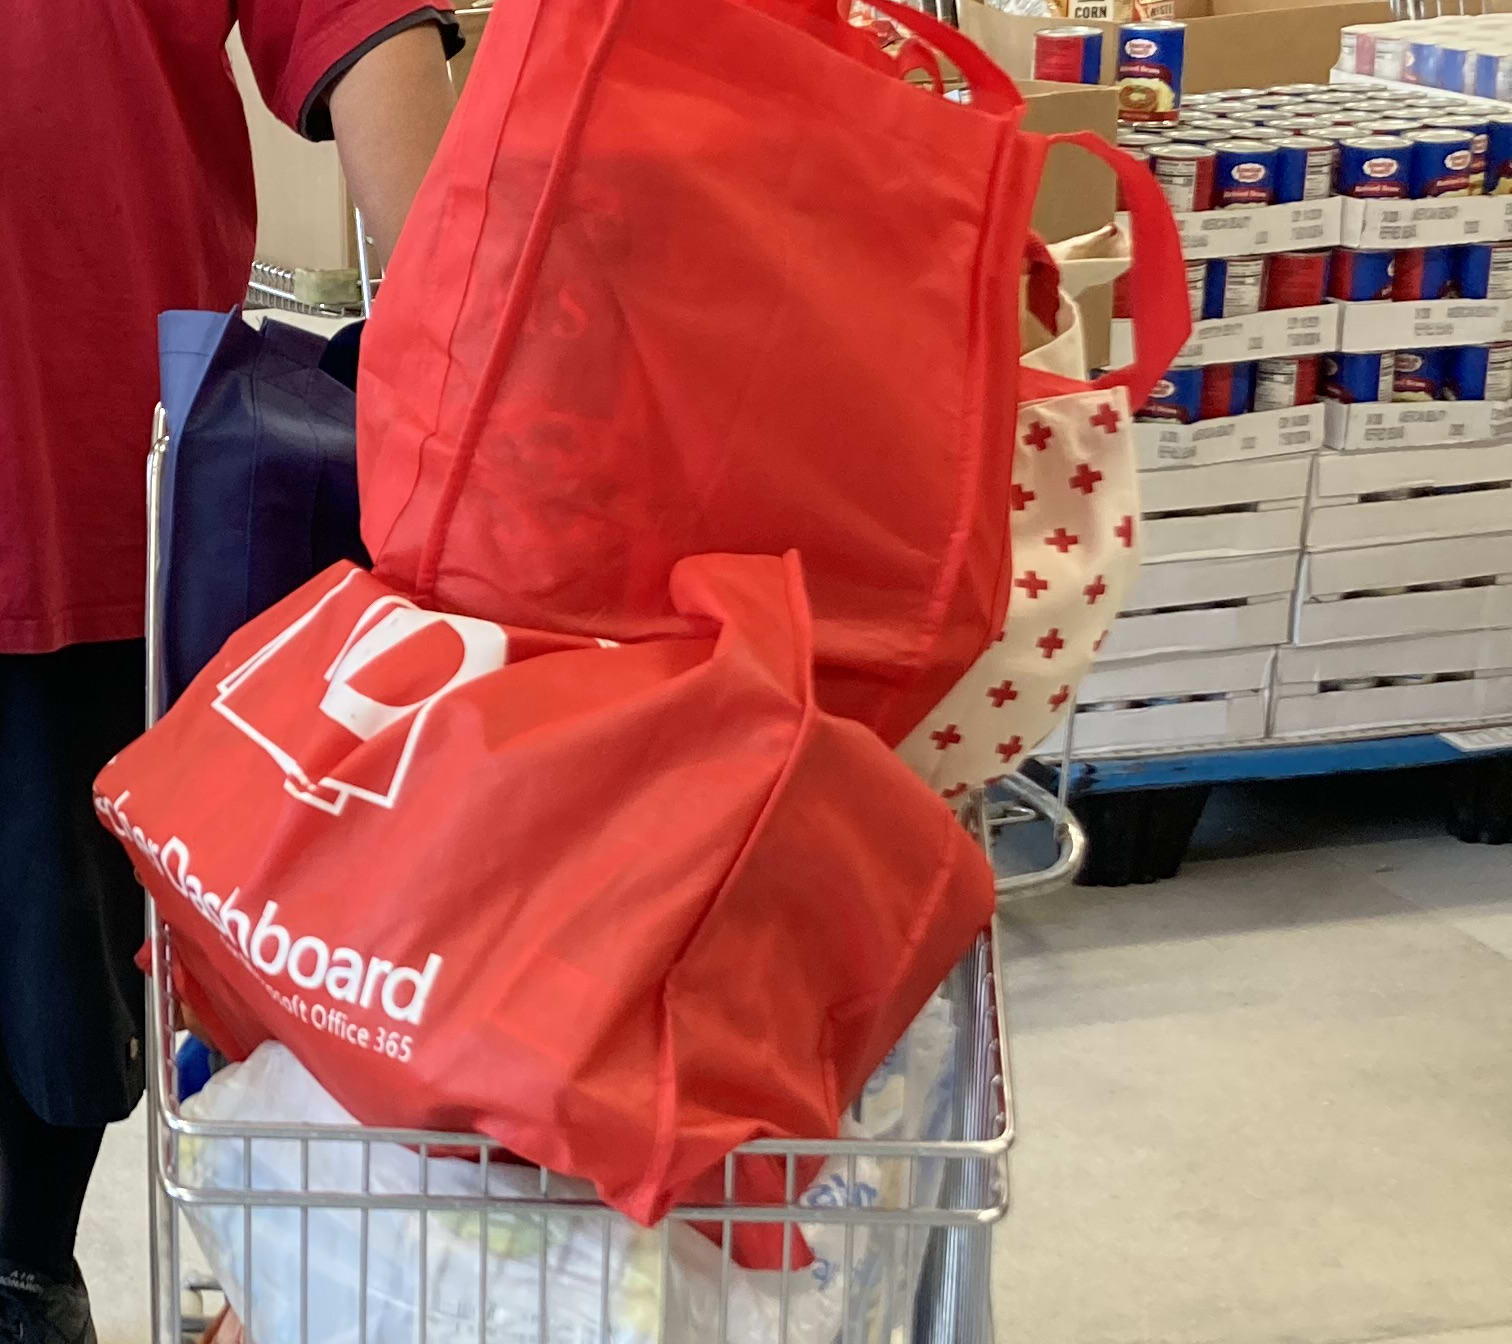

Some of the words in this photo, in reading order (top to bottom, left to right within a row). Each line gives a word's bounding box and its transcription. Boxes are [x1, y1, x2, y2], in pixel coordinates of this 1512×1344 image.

[1075, 6, 1107, 18] CORN
[311, 1004, 369, 1048] Office
[373, 1027, 414, 1064] 365
